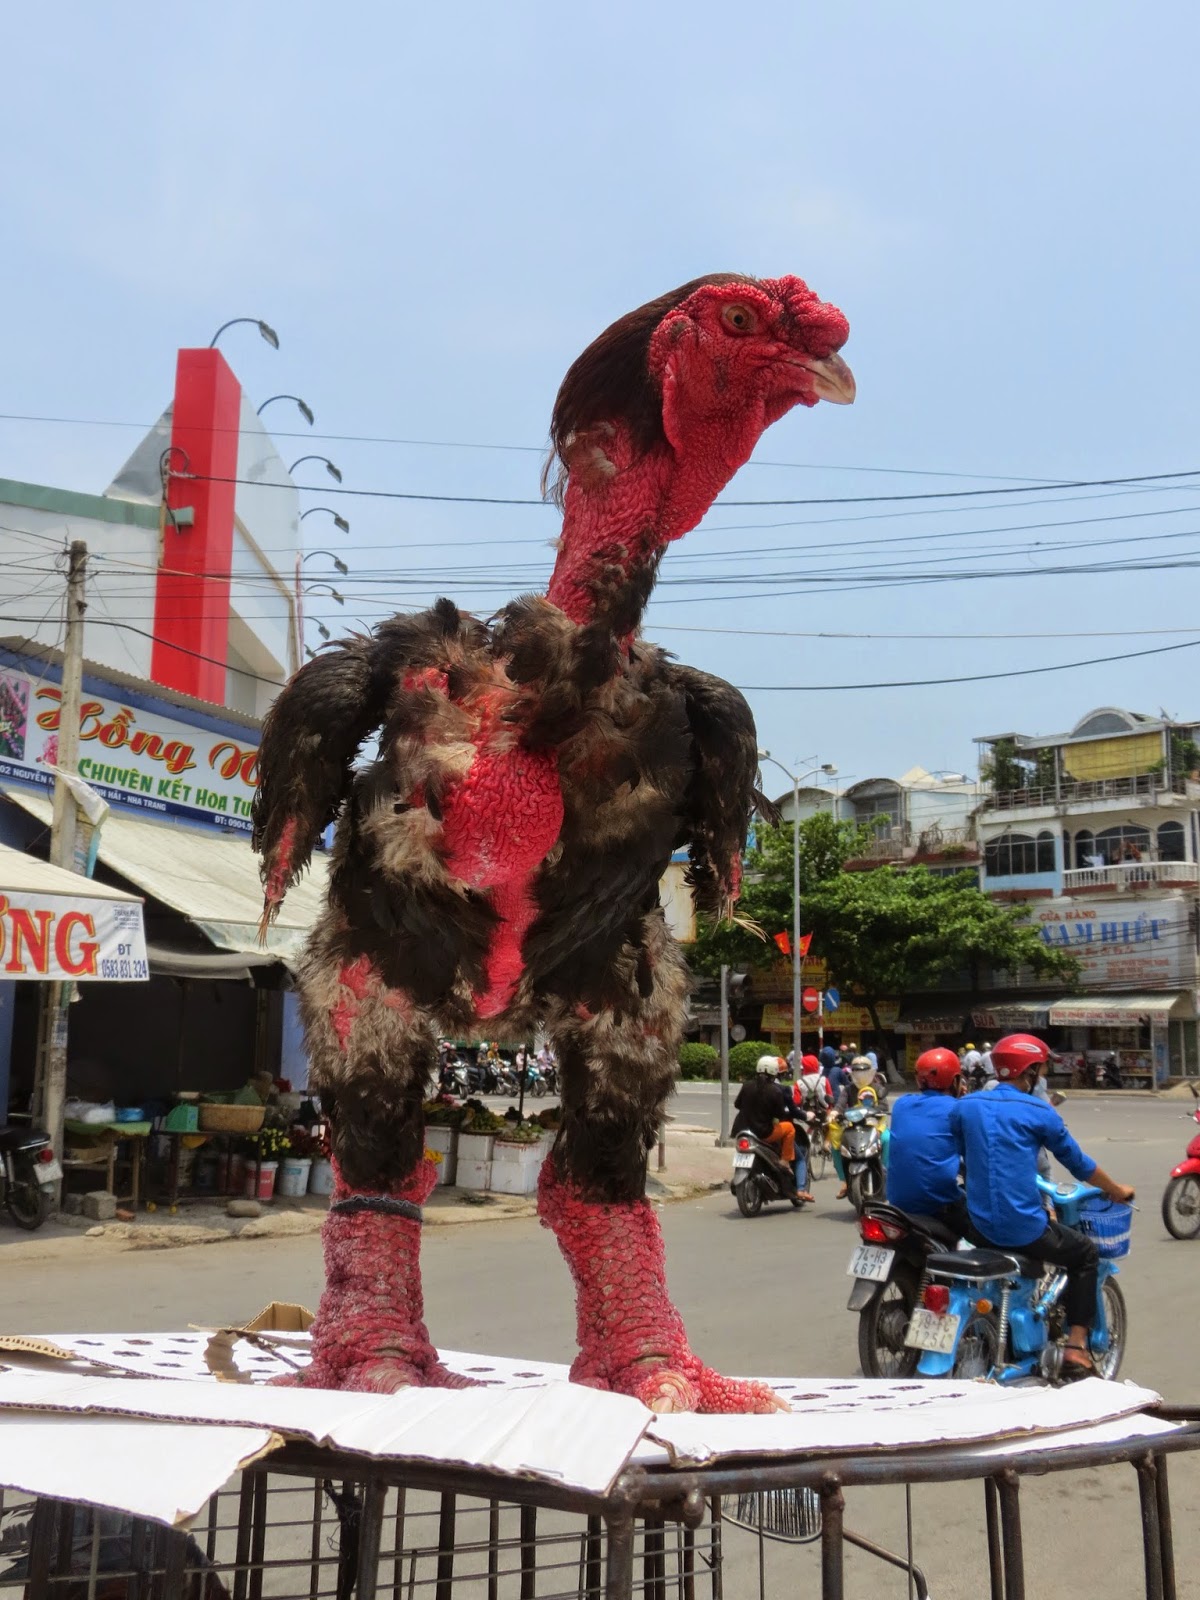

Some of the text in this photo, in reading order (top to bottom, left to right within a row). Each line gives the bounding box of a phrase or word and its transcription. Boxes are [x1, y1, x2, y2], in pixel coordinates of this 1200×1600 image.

[13, 768, 47, 784] NGUYỄN
[78, 758, 152, 793] CHUYÊN
[157, 777, 192, 802] KẾT
[195, 788, 227, 812] HOA
[108, 789, 121, 801] HẢI
[127, 795, 142, 806] NHA
[143, 799, 167, 811] TRANG
[118, 943, 132, 955] ĐT
[853, 1261, 882, 1277] 4671
